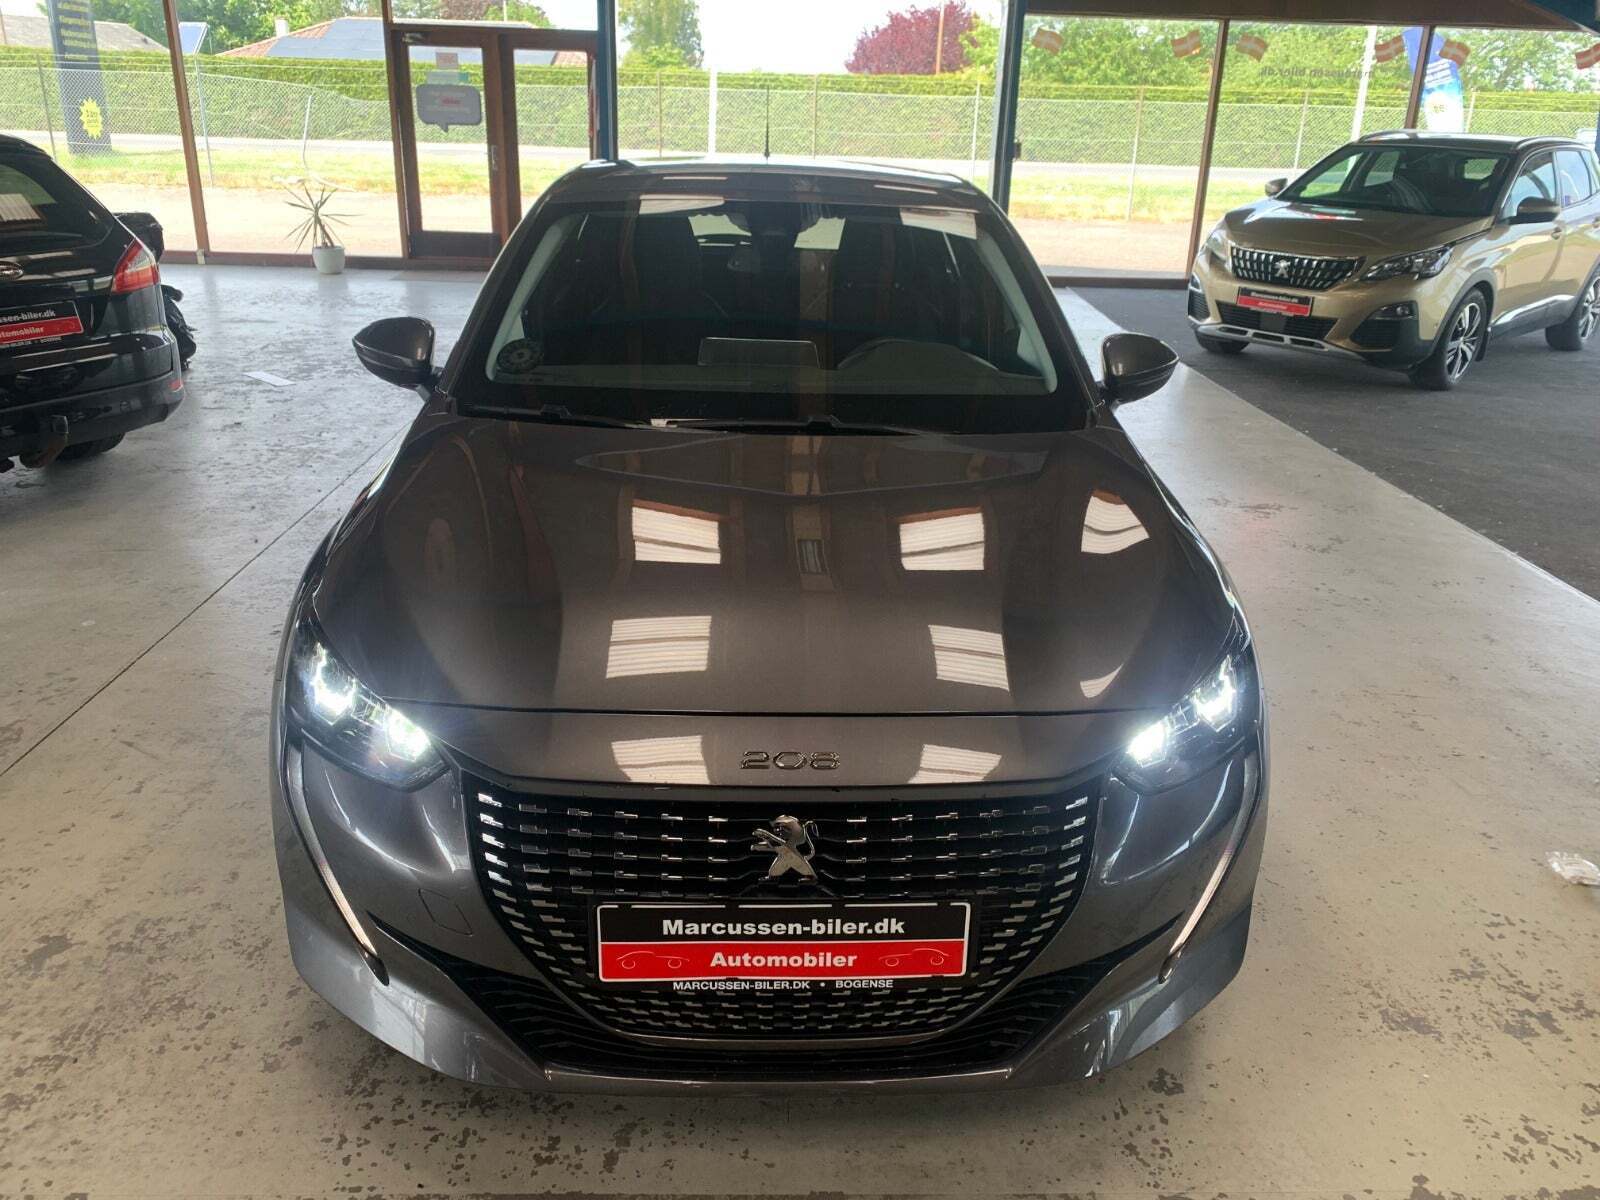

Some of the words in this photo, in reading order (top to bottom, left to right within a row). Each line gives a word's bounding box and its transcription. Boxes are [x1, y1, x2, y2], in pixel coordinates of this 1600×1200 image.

[740, 751, 840, 770] 208
[662, 918, 906, 935] Marcussen-biler.dk
[710, 951, 857, 967] Automobiler
[673, 980, 811, 990] MARCUSSEN-BILER.DK
[835, 979, 894, 988] BOGENSE
